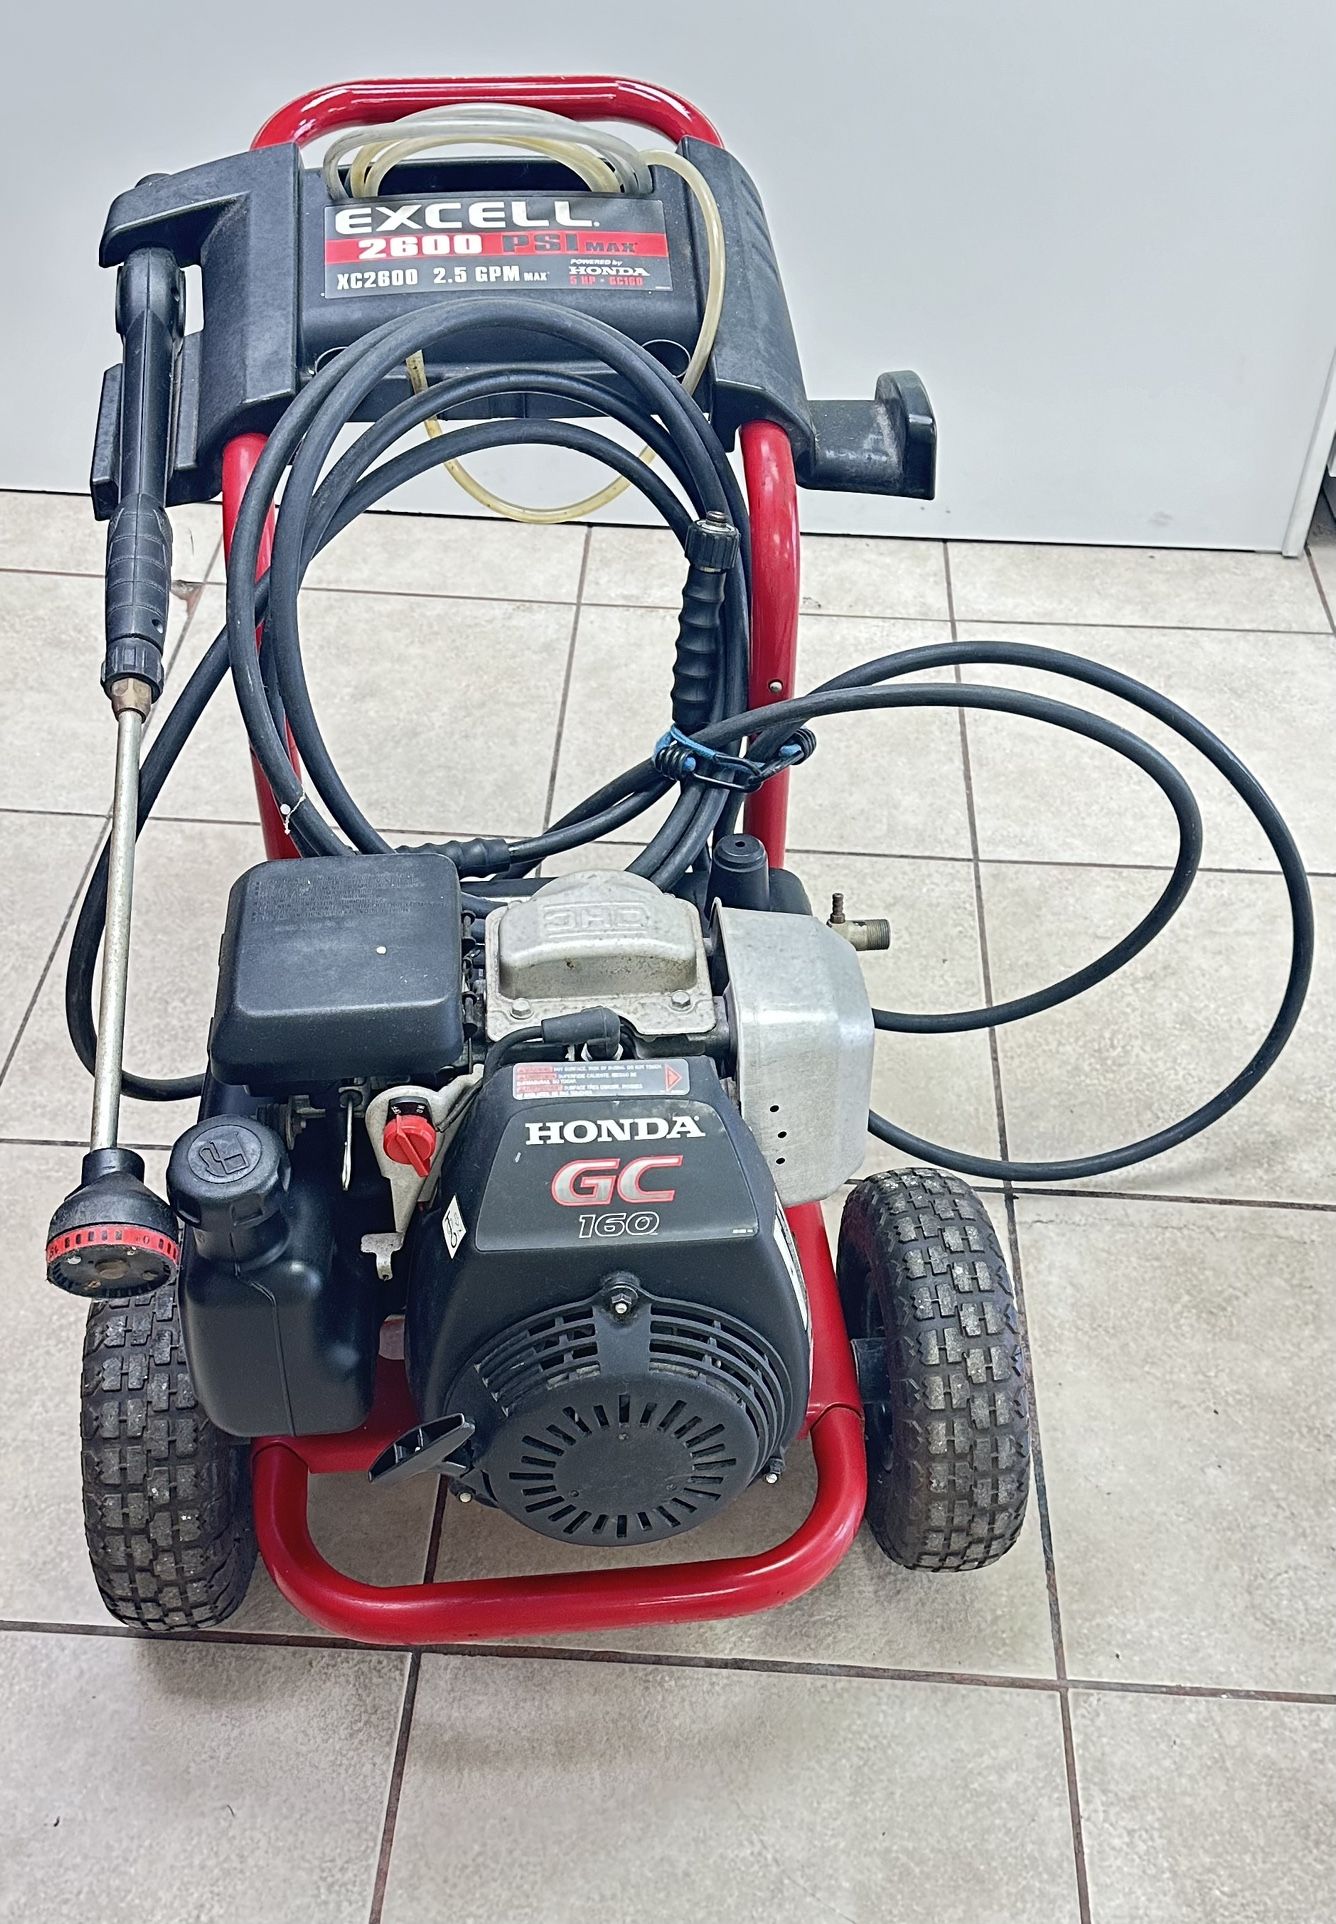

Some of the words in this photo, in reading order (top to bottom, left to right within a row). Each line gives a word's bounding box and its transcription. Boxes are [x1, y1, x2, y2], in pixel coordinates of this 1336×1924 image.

[358, 234, 483, 260] 2600
[502, 233, 578, 253] PSI
[336, 268, 419, 291] XC2600
[432, 266, 467, 284] 2.5
[475, 265, 521, 283] GPM
[569, 266, 651, 277] HONDA
[525, 1115, 706, 1145] HONDA
[551, 1155, 683, 1207] GC
[578, 1211, 660, 1239] 160
